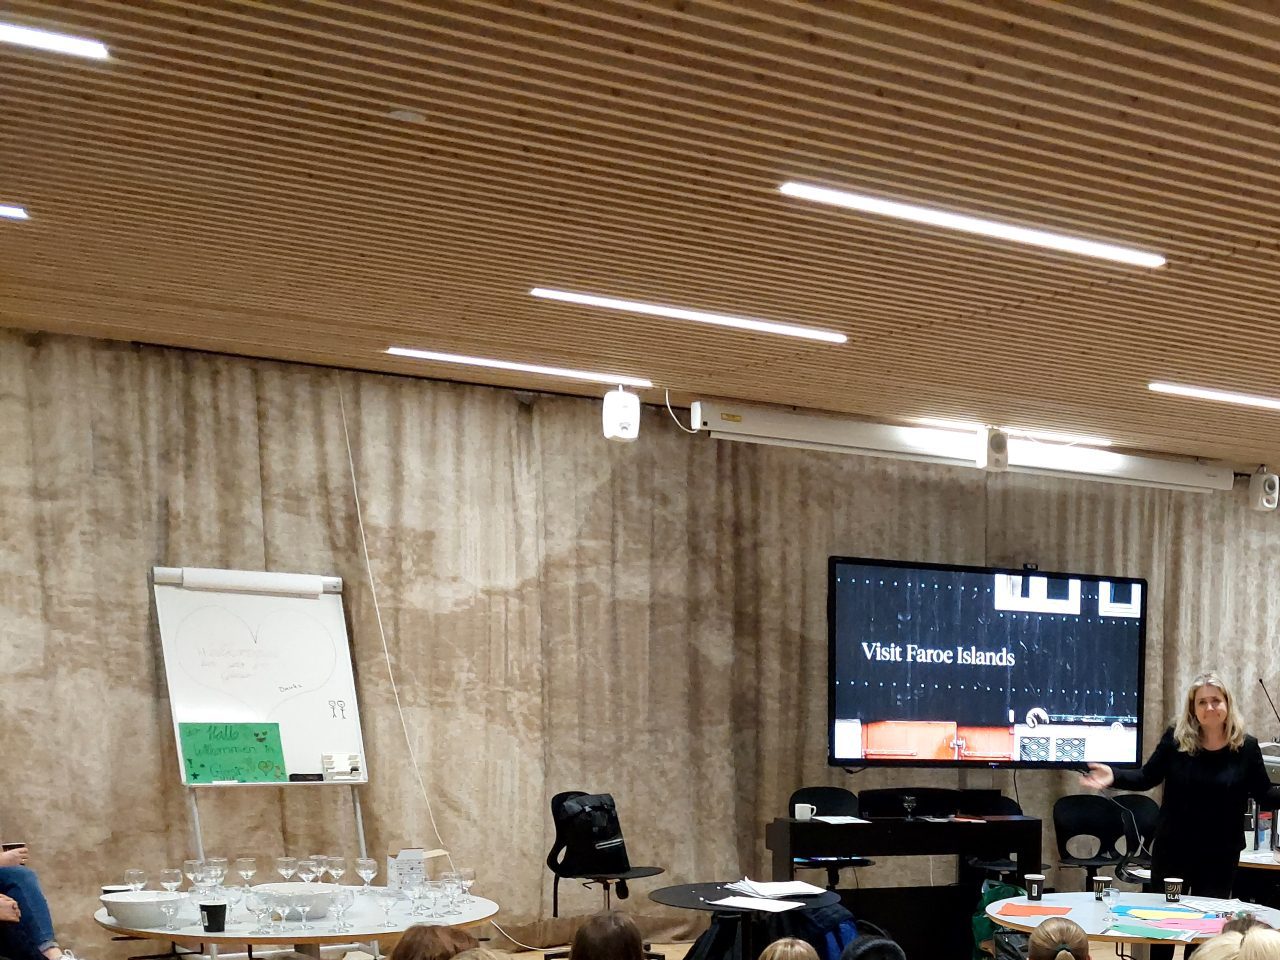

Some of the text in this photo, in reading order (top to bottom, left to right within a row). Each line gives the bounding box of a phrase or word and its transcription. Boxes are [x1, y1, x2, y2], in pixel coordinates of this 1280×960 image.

[861, 642, 1016, 666] Visit Faroe Islands
